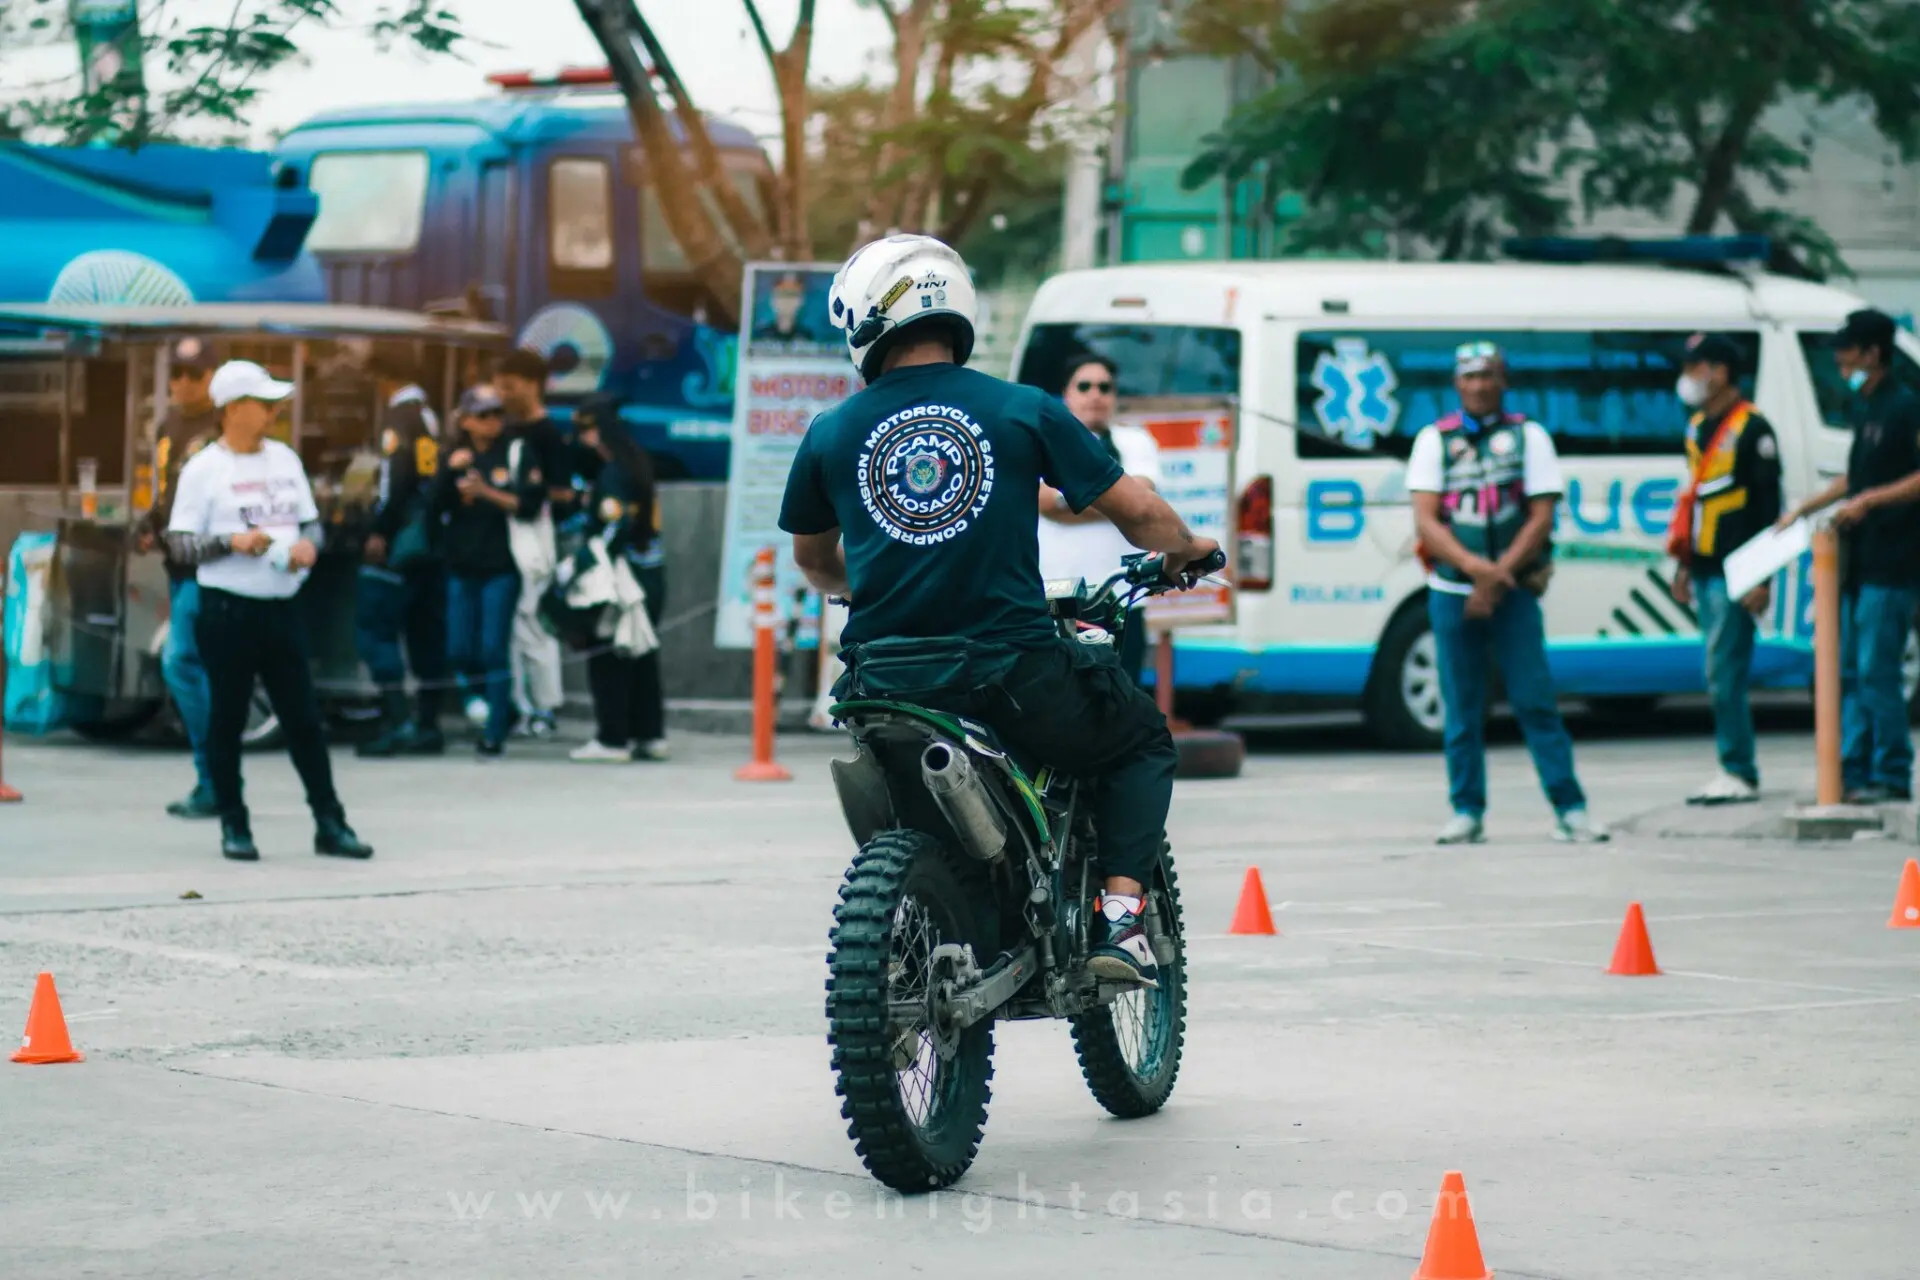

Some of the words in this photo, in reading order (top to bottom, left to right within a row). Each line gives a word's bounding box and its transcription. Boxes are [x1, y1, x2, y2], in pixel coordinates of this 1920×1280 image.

[916, 280, 948, 290] HNJ
[865, 404, 983, 449] MOTORCYCLE
[886, 434, 962, 476] PCAMP
[857, 453, 968, 546] COMPREHENSION
[888, 473, 963, 514] MOSACO
[971, 439, 995, 518] SAFETY
